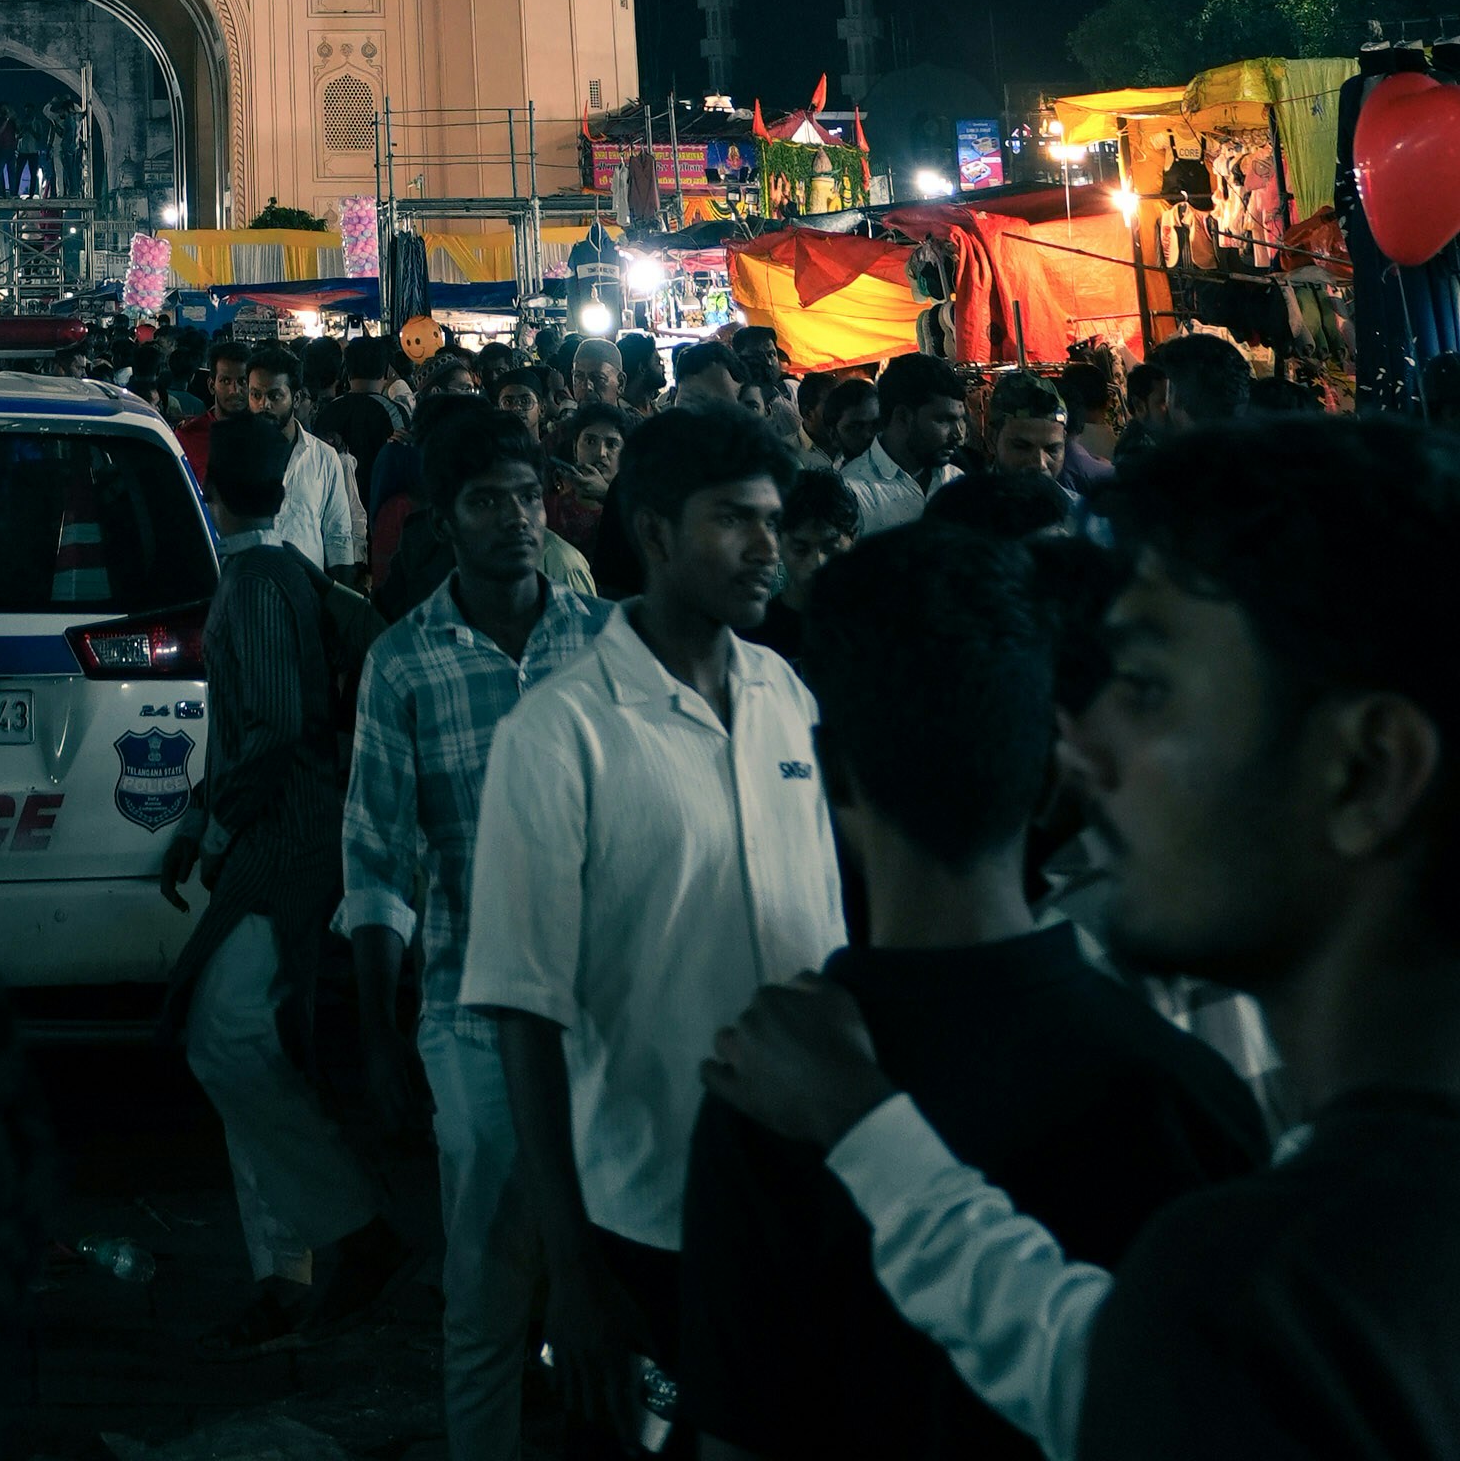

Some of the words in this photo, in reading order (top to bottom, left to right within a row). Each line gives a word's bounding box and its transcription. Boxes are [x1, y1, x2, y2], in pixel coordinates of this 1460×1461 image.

[126, 765, 163, 777] TELANGANA
[164, 765, 183, 776] STATE
[122, 777, 184, 792] POLICE
